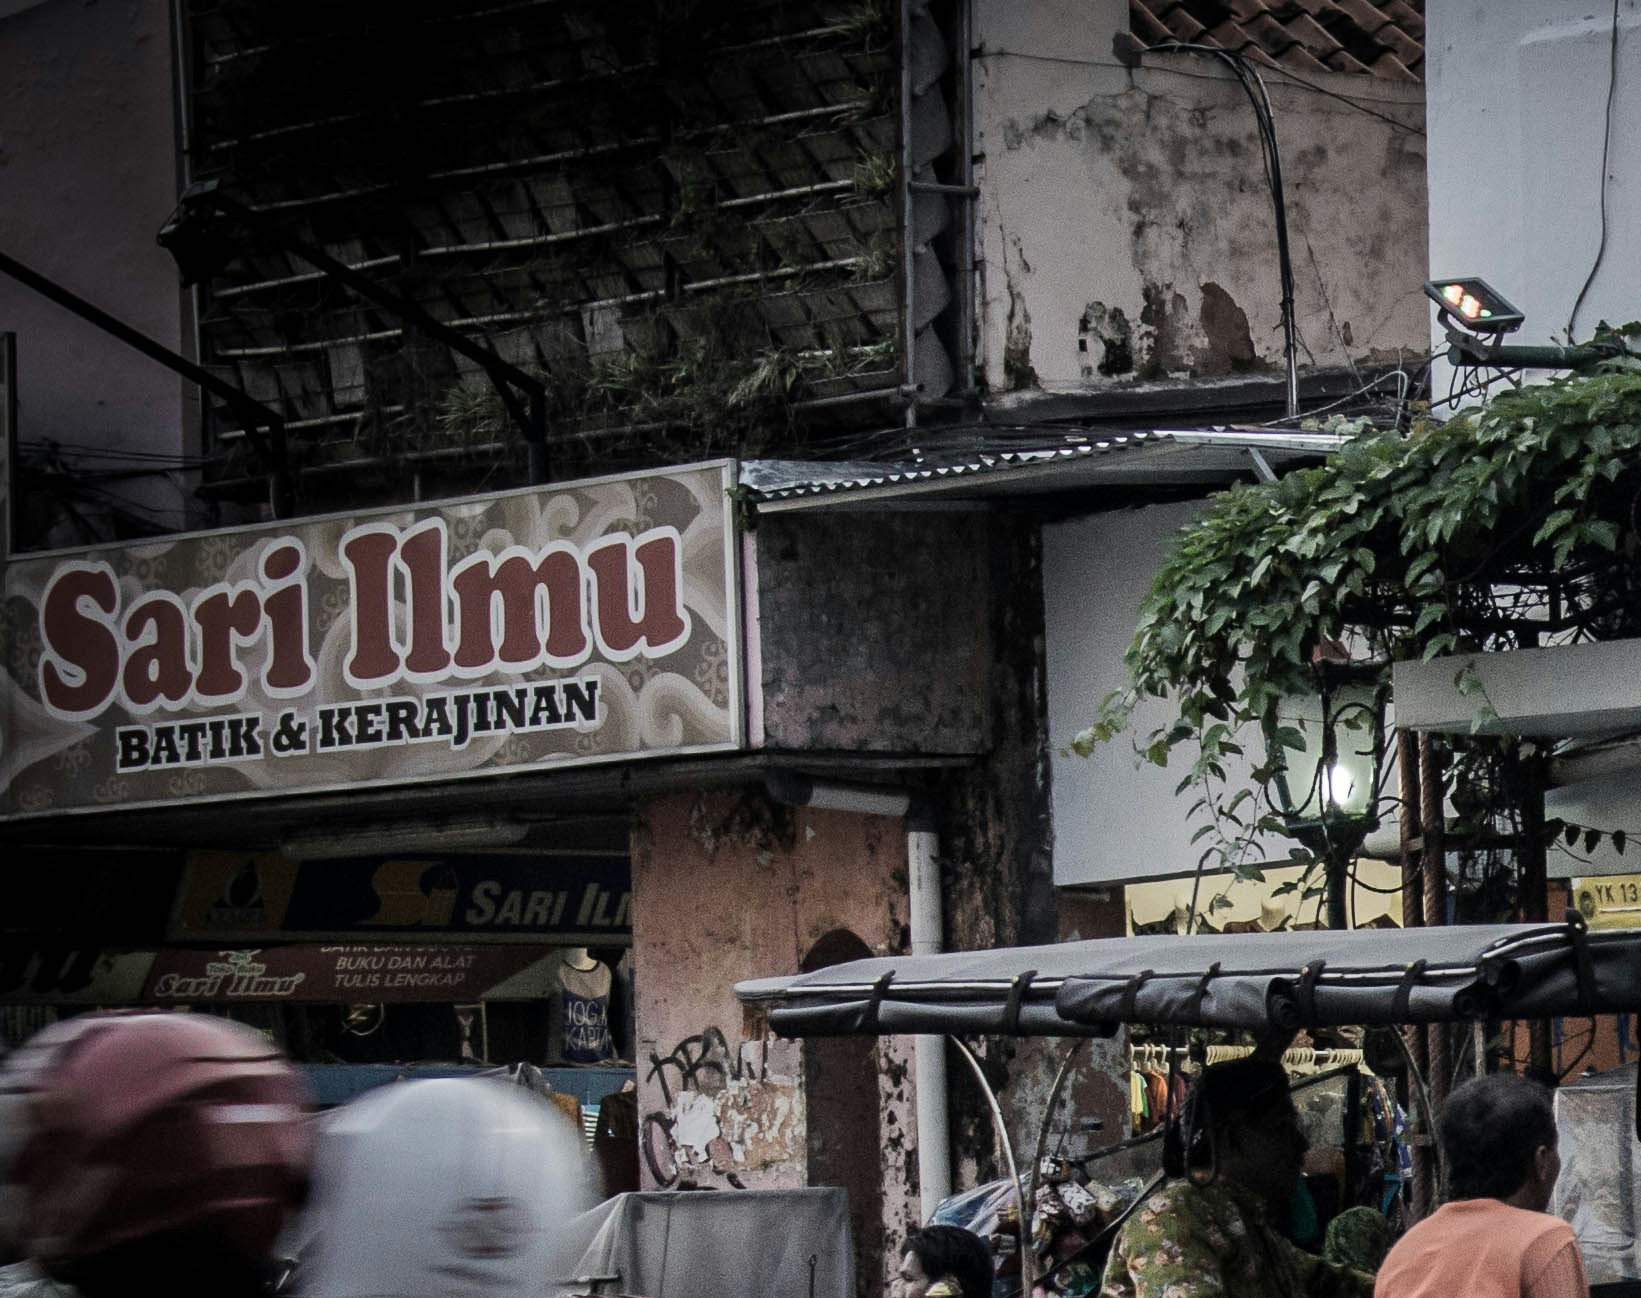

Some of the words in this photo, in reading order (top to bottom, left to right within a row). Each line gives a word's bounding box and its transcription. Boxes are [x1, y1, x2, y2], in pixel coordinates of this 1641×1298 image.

[41, 543, 314, 716] Sari
[342, 522, 687, 685] Ilmu
[118, 717, 262, 769] BATIK
[272, 712, 306, 751] &
[318, 681, 598, 745] KERAJINAN
[1595, 884, 1615, 904] YK
[335, 955, 385, 970] BUKU
[388, 954, 427, 970] DAN
[429, 954, 476, 969] ALAT
[154, 973, 223, 998] Sari
[226, 974, 303, 997] Ilmu
[334, 973, 381, 988] TULIS
[383, 972, 465, 988] LENGKAP
